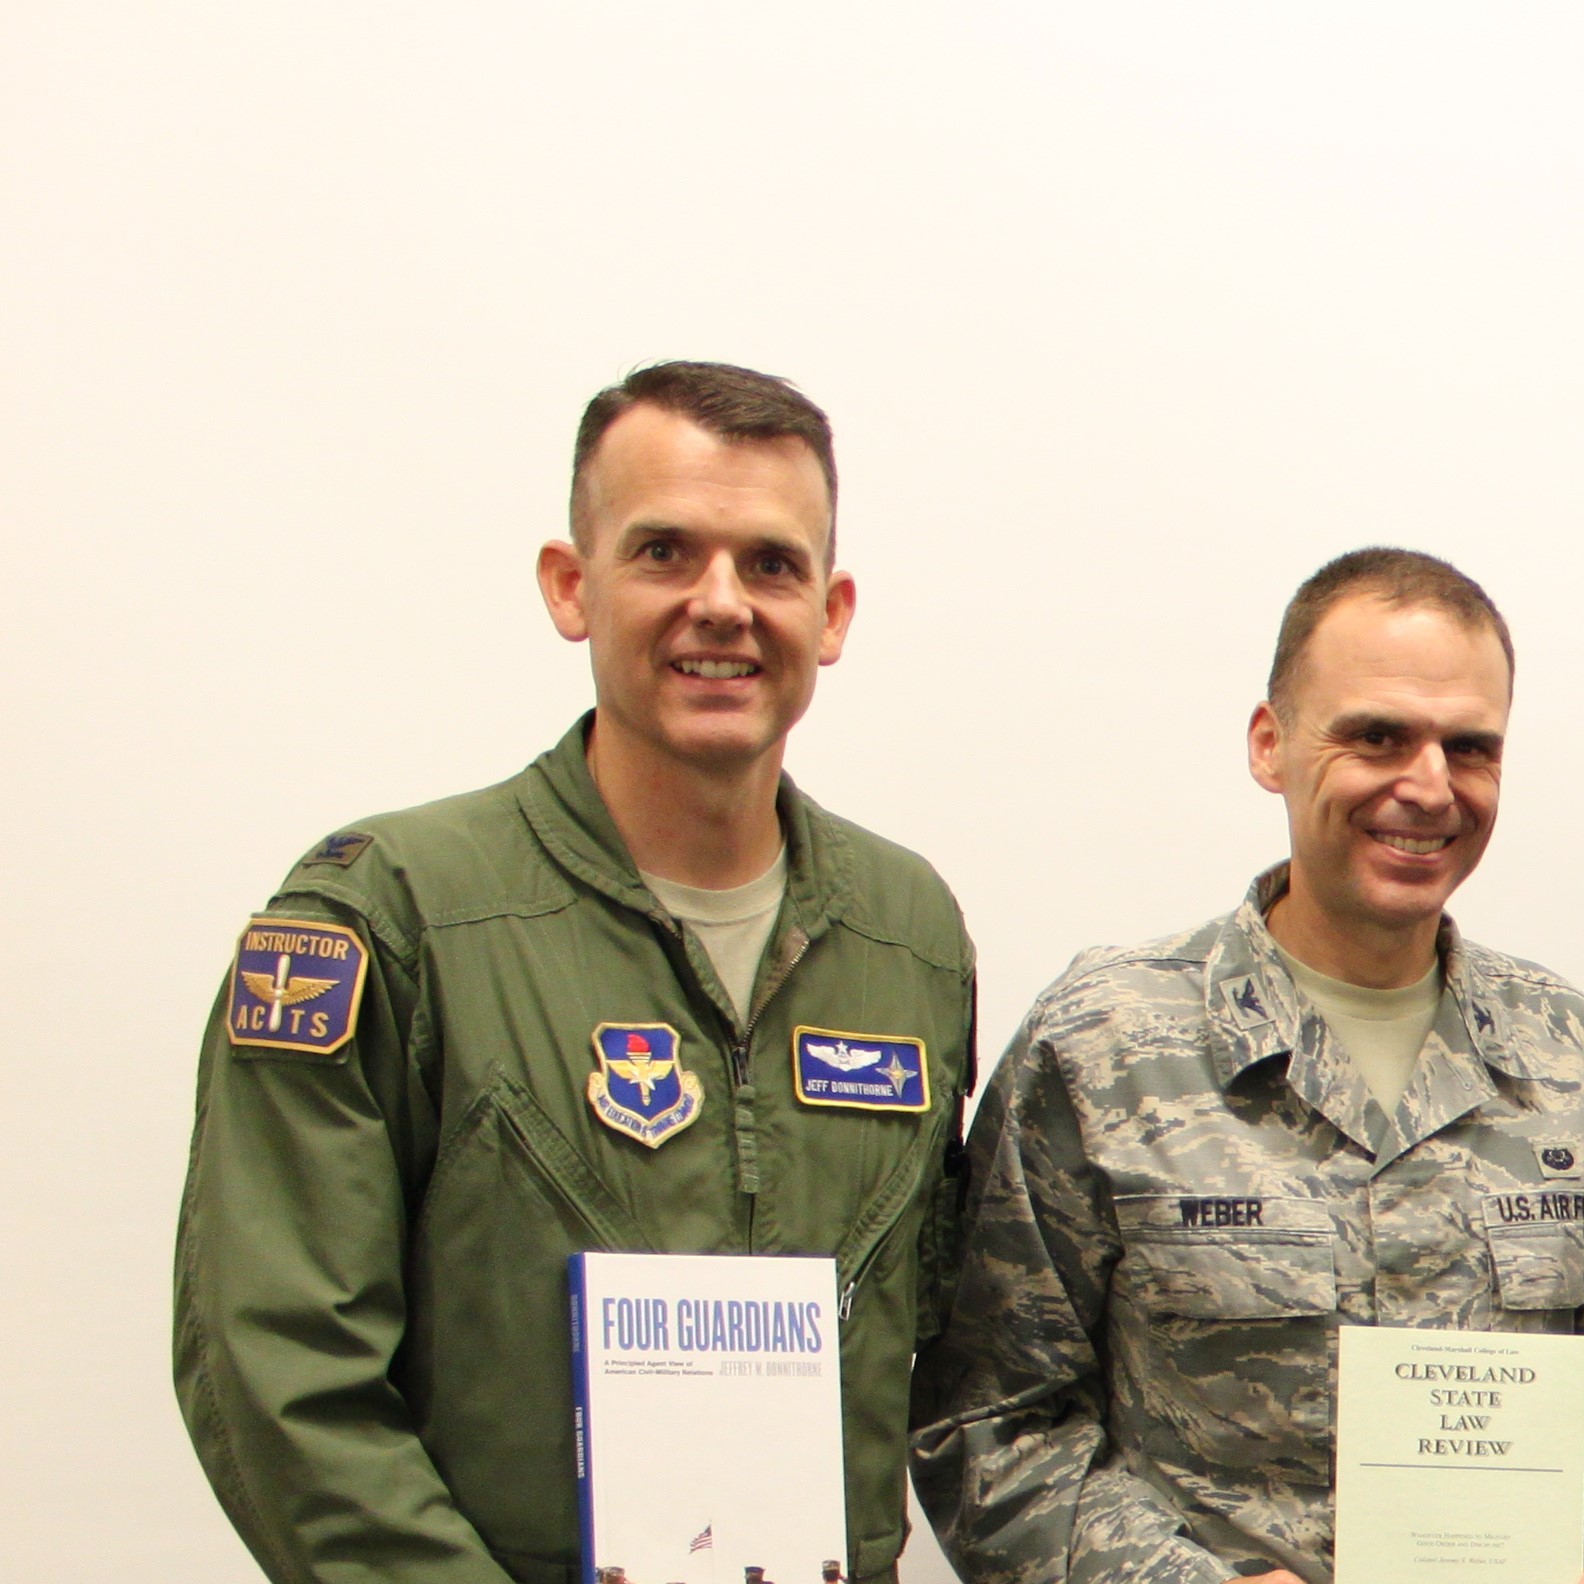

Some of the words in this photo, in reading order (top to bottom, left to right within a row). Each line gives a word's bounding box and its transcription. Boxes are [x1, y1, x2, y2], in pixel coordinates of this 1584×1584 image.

[245, 931, 350, 961] INSTRUCTOR
[805, 1079, 830, 1092] JEFF
[831, 1080, 894, 1097] DONNITHORNE
[1179, 1198, 1264, 1227] WEBER
[1496, 1195, 1536, 1222] U.S.
[1540, 1194, 1571, 1220] AIR
[602, 1298, 668, 1351] FOUR
[677, 1299, 822, 1354] GUARDIANS
[1395, 1362, 1537, 1385] CLEVELAND
[1429, 1388, 1502, 1408] STATE
[1440, 1414, 1492, 1432] LAW
[1417, 1438, 1514, 1457] REVIEW
